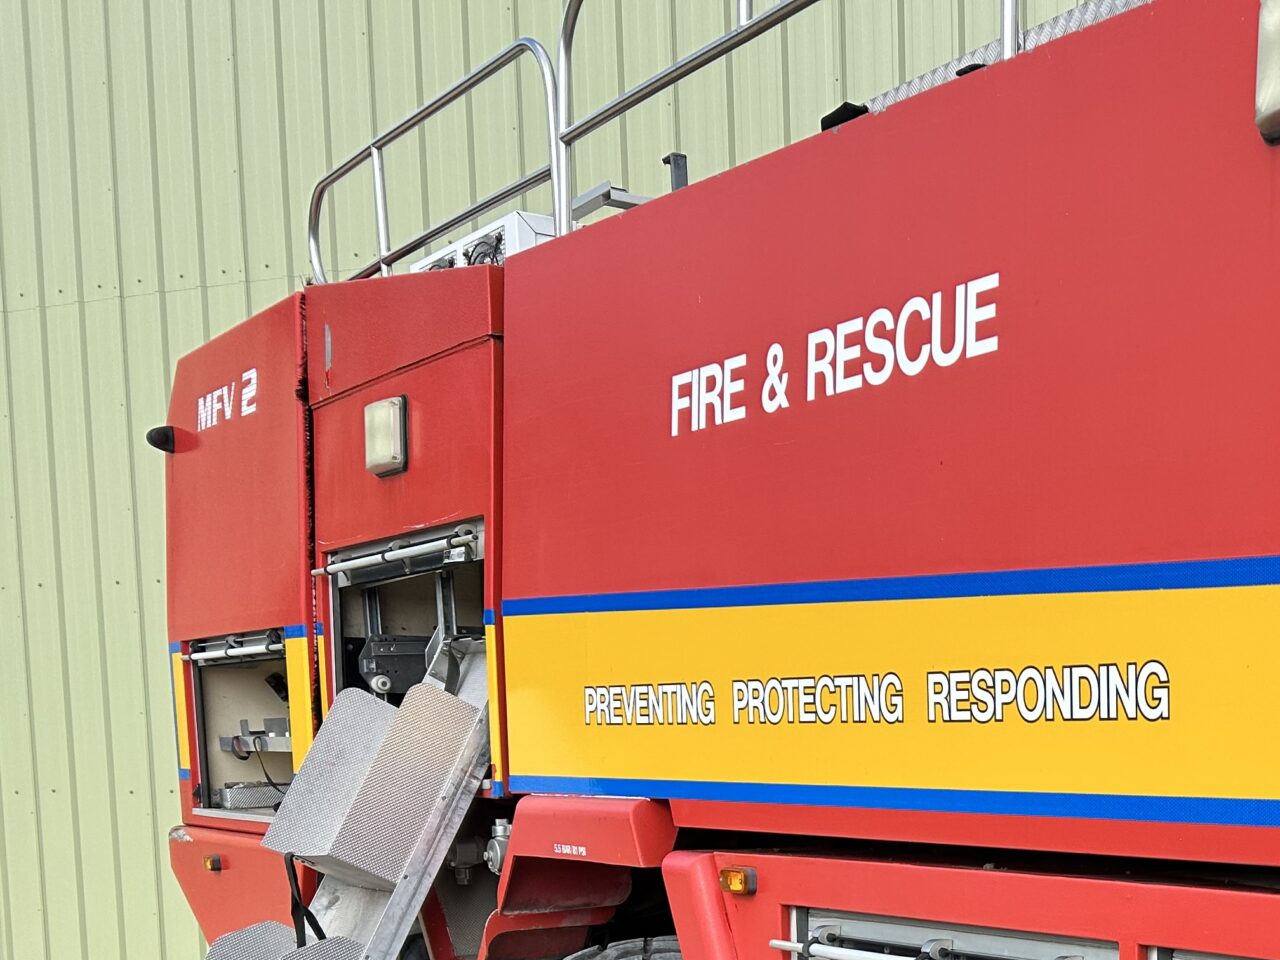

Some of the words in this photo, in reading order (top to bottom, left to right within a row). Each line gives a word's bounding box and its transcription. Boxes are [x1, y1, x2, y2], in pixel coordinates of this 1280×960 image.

[671, 353, 747, 437] FIRE
[761, 343, 790, 413] &
[806, 271, 1000, 402] RESCUE
[197, 381, 235, 432] MFV
[241, 367, 257, 416] 2
[584, 681, 715, 726] PREVENTING
[731, 672, 904, 725] PROTECTING
[926, 659, 1171, 724] RESPONDING
